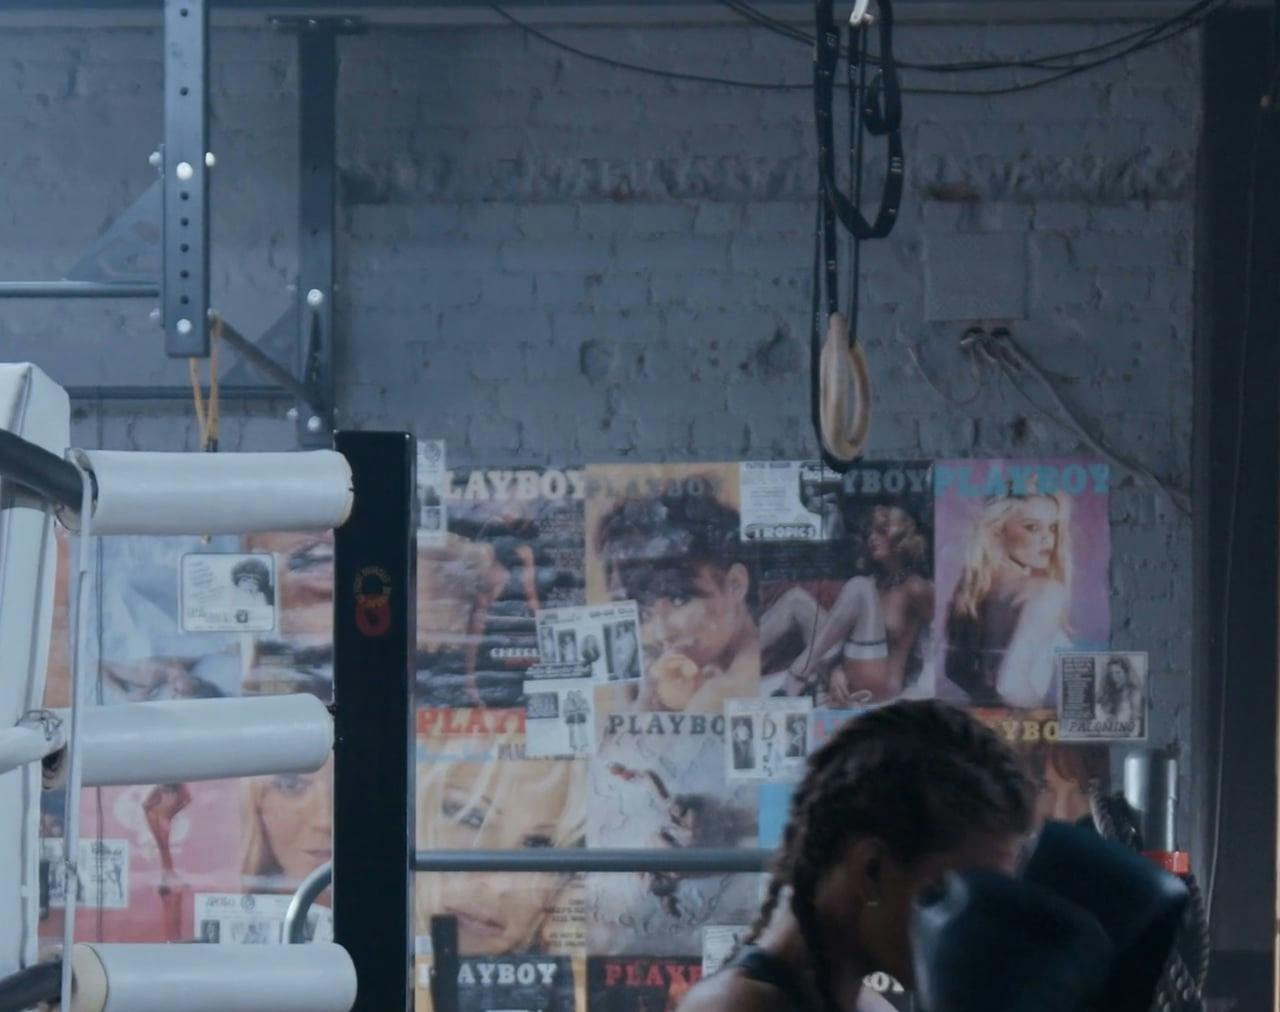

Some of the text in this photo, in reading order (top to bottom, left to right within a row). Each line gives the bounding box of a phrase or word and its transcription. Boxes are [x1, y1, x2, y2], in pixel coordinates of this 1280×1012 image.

[446, 470, 585, 500] LAYBOY
[842, 468, 929, 493] YBOY
[933, 464, 1111, 497] PLAYBOY
[608, 714, 725, 735] PLAYBO
